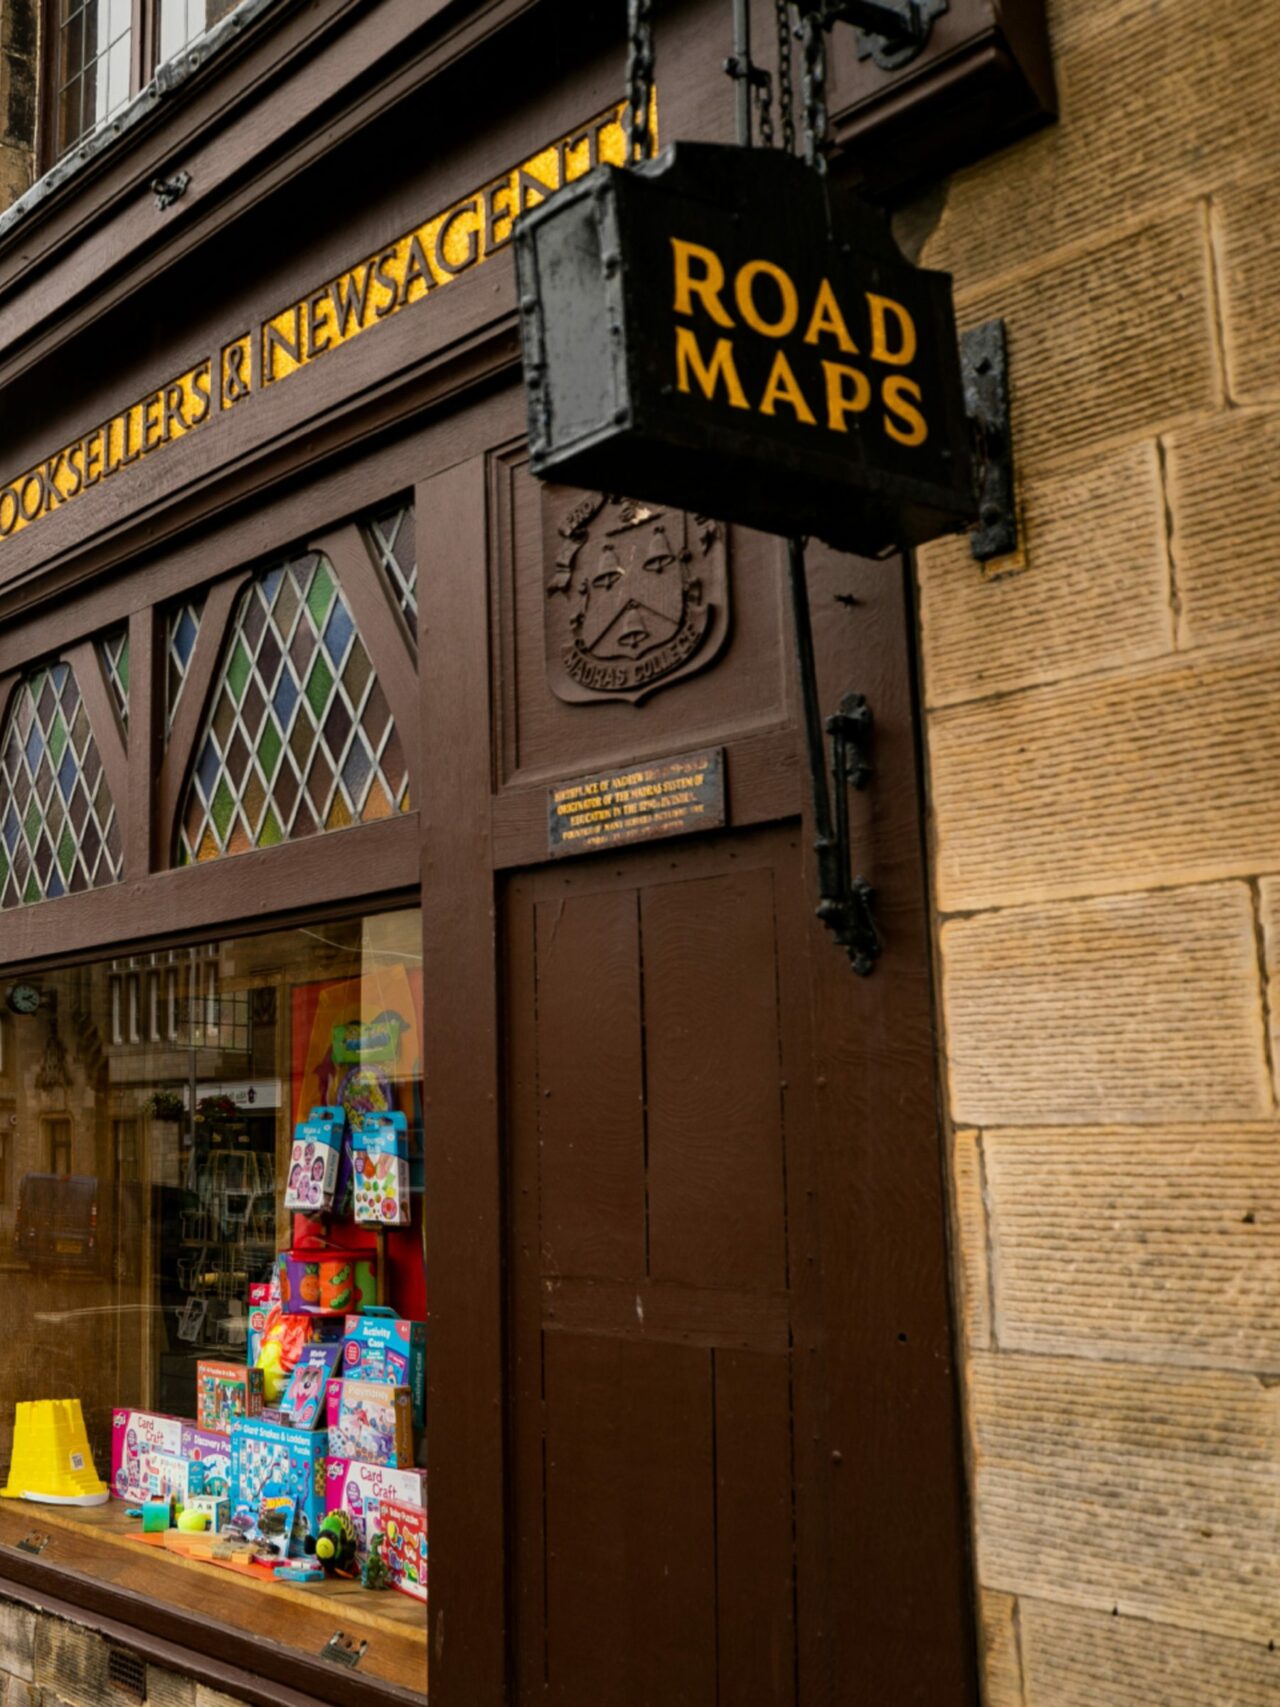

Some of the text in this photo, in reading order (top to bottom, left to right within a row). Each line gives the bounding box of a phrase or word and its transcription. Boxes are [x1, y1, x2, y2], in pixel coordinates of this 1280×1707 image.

[670, 237, 917, 367] ROAD
[224, 345, 251, 401] &
[675, 325, 928, 447] MAPS
[563, 623, 701, 687] MADRAS COLLEGE
[363, 1327, 391, 1339] Activity
[367, 1338, 385, 1348] Case
[138, 1416, 154, 1431] Card
[146, 1430, 164, 1445] Craft
[360, 1466, 383, 1483] Card
[372, 1482, 397, 1500] Craft
